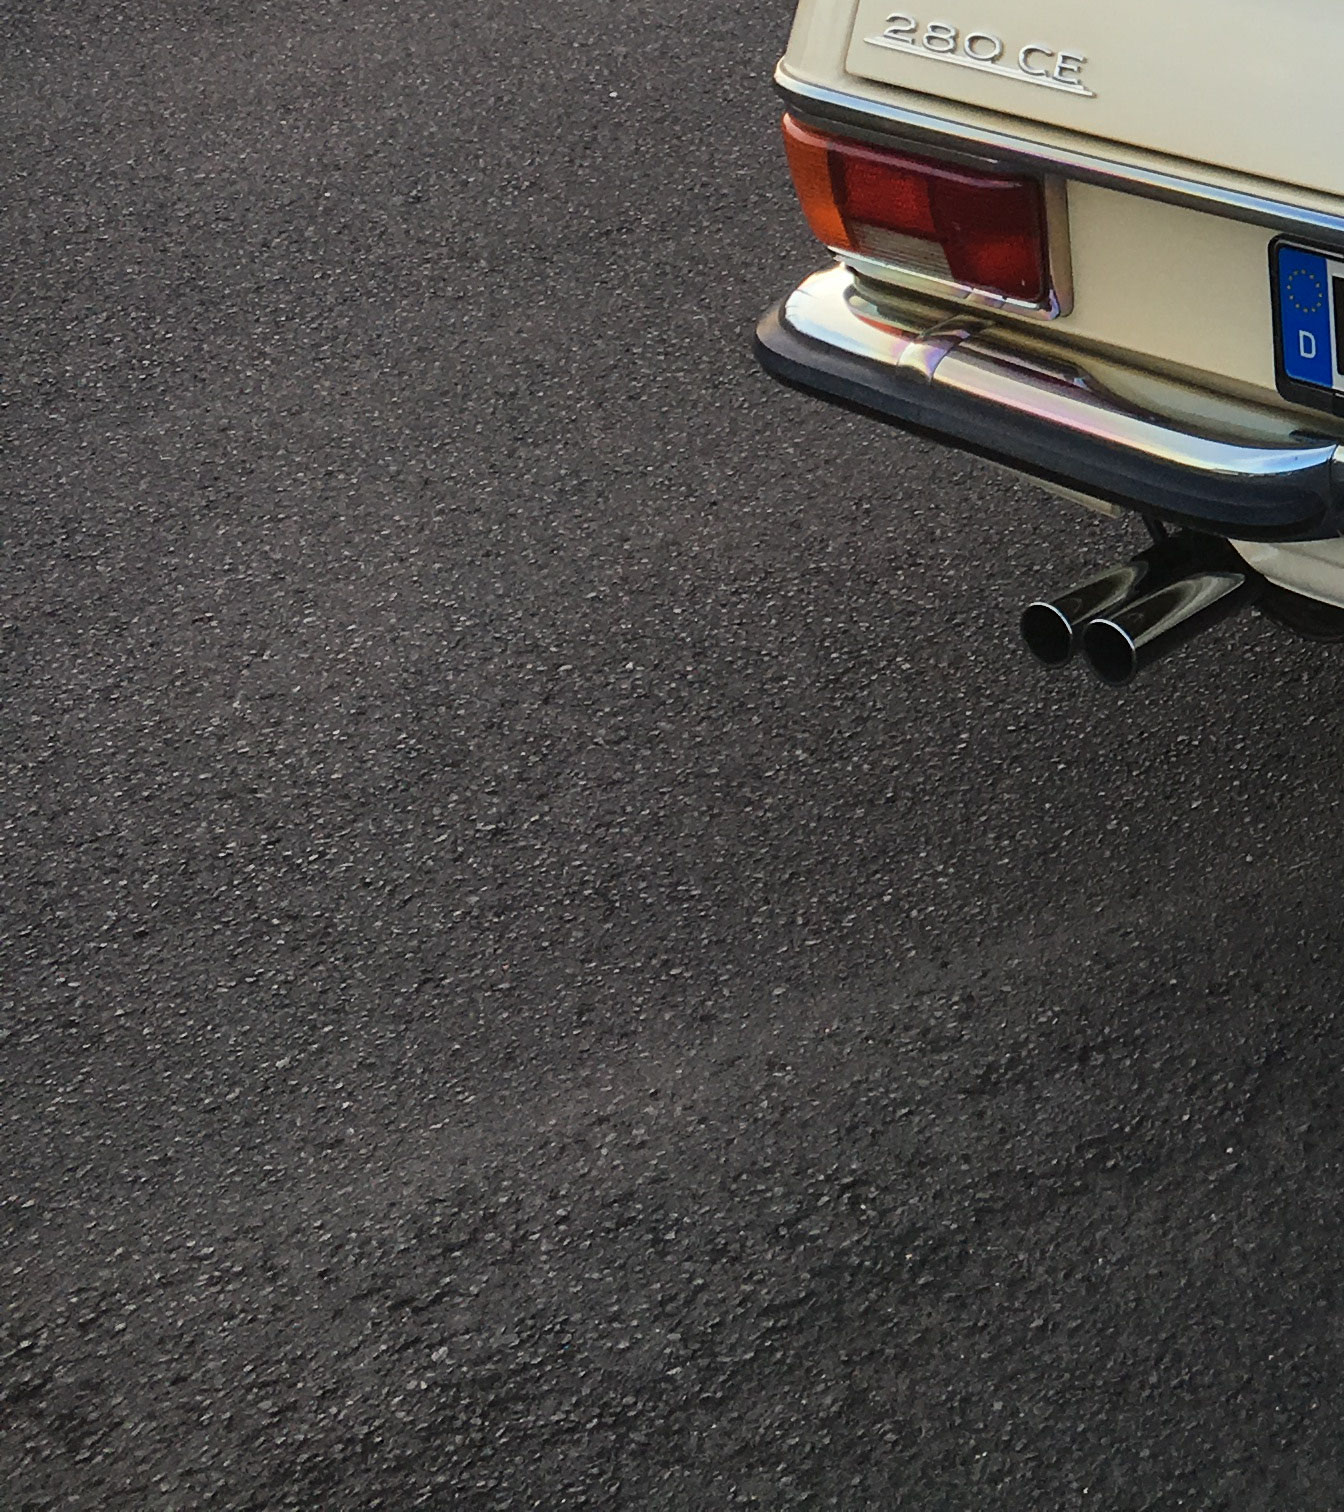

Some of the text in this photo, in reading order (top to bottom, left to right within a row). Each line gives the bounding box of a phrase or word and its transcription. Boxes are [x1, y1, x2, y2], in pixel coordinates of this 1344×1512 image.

[884, 13, 1088, 85] 280 CE
[1299, 330, 1316, 358] D
